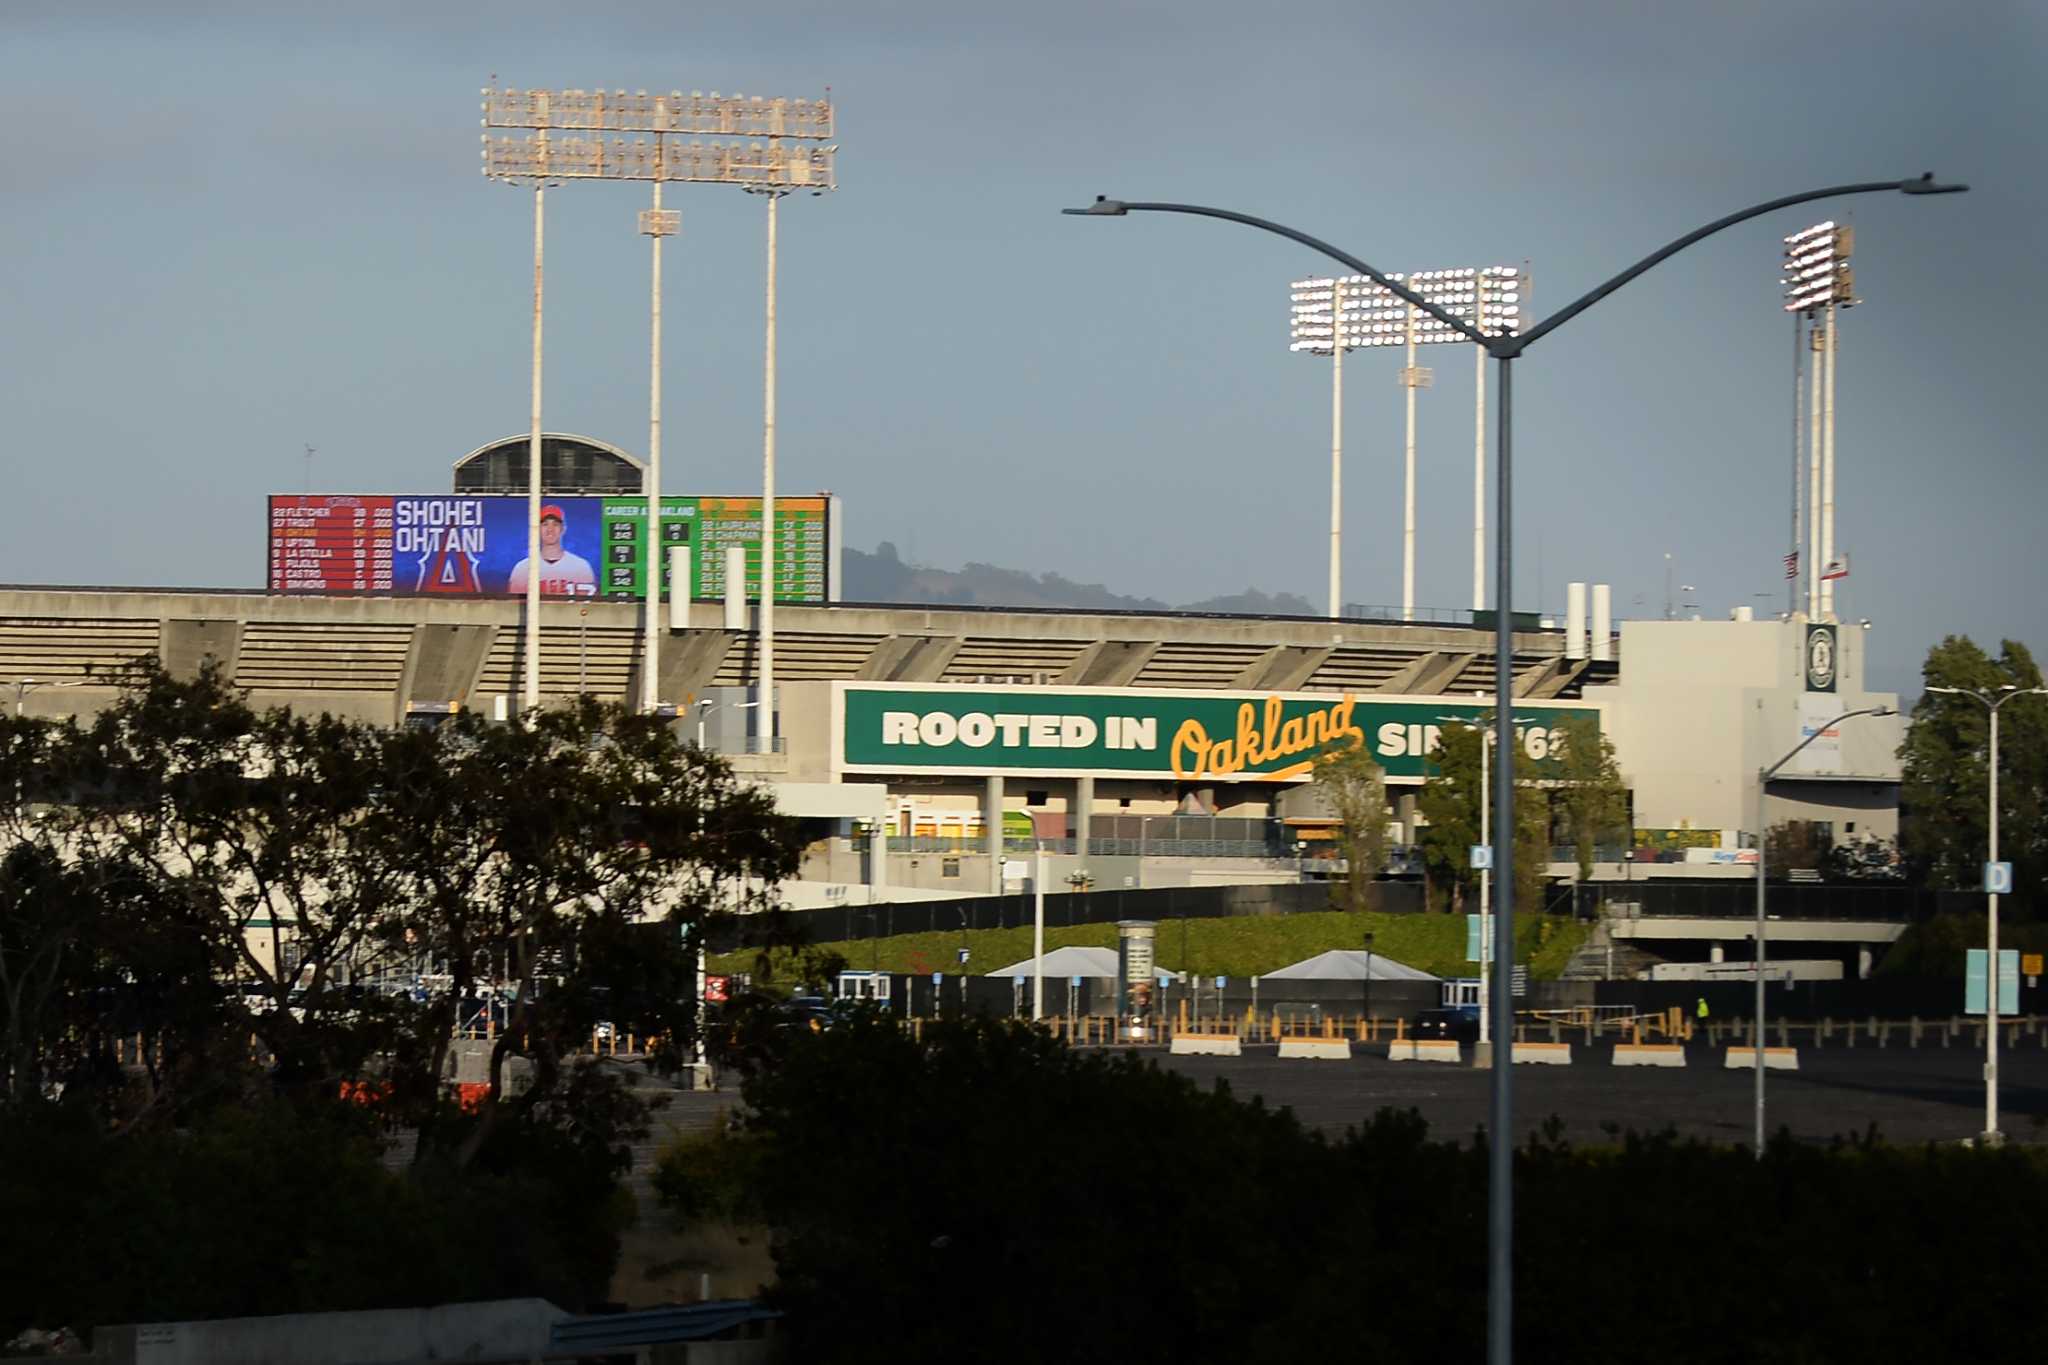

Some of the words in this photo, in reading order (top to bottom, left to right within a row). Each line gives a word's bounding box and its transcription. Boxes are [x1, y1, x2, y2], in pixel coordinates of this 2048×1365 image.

[396, 500, 483, 526] SHOHEI
[396, 527, 485, 553] OHTANI
[881, 711, 1098, 748] ROOTED
[1104, 715, 1157, 751] IN
[1171, 693, 1364, 781] Oakland
[1990, 864, 2009, 891] D
